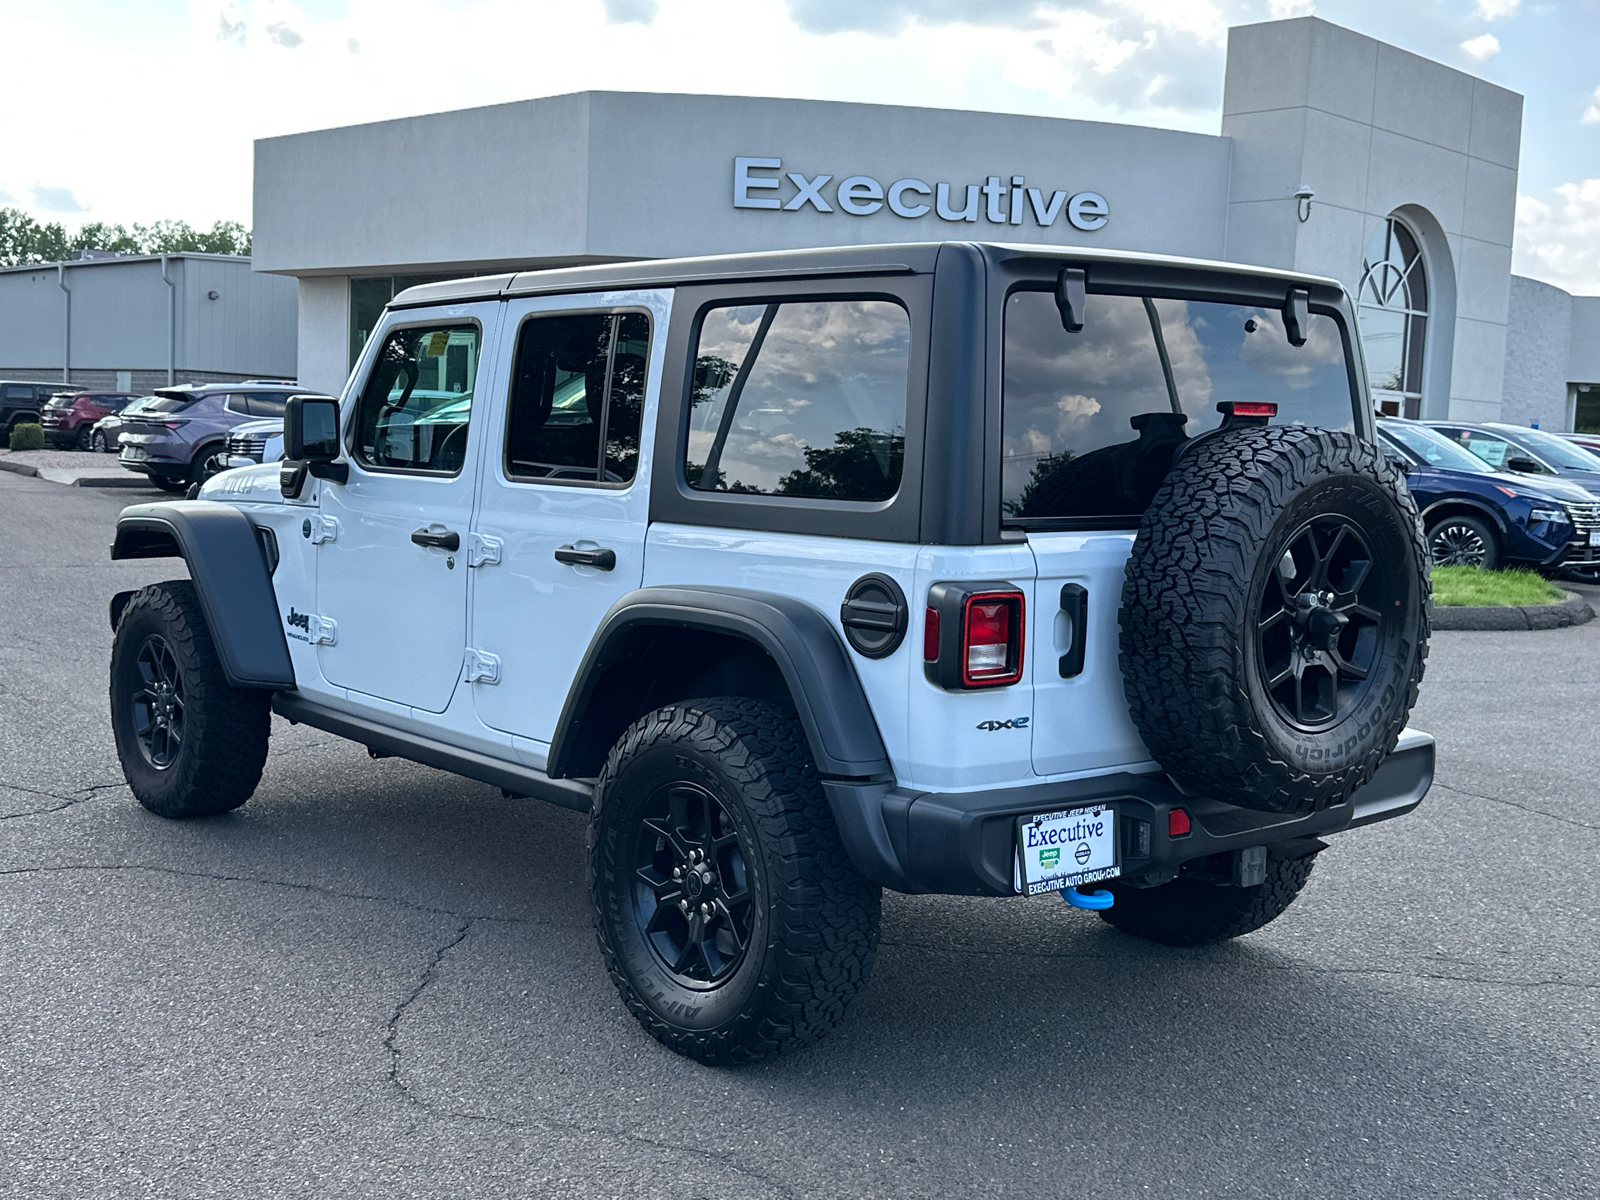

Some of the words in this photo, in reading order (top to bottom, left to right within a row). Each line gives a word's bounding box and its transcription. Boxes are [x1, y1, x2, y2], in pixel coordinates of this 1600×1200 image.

[733, 155, 1110, 232] Executive
[1033, 810, 1067, 823] EXECUTIVE
[1068, 808, 1084, 817] JEEP
[1084, 804, 1107, 814] NISSAN
[1027, 818, 1104, 848] Executive
[1042, 850, 1058, 858] Jeep
[1028, 878, 1064, 895] EXECUTIVE
[1065, 874, 1082, 887] AUTO
[1083, 866, 1121, 883] GROUP.COM
